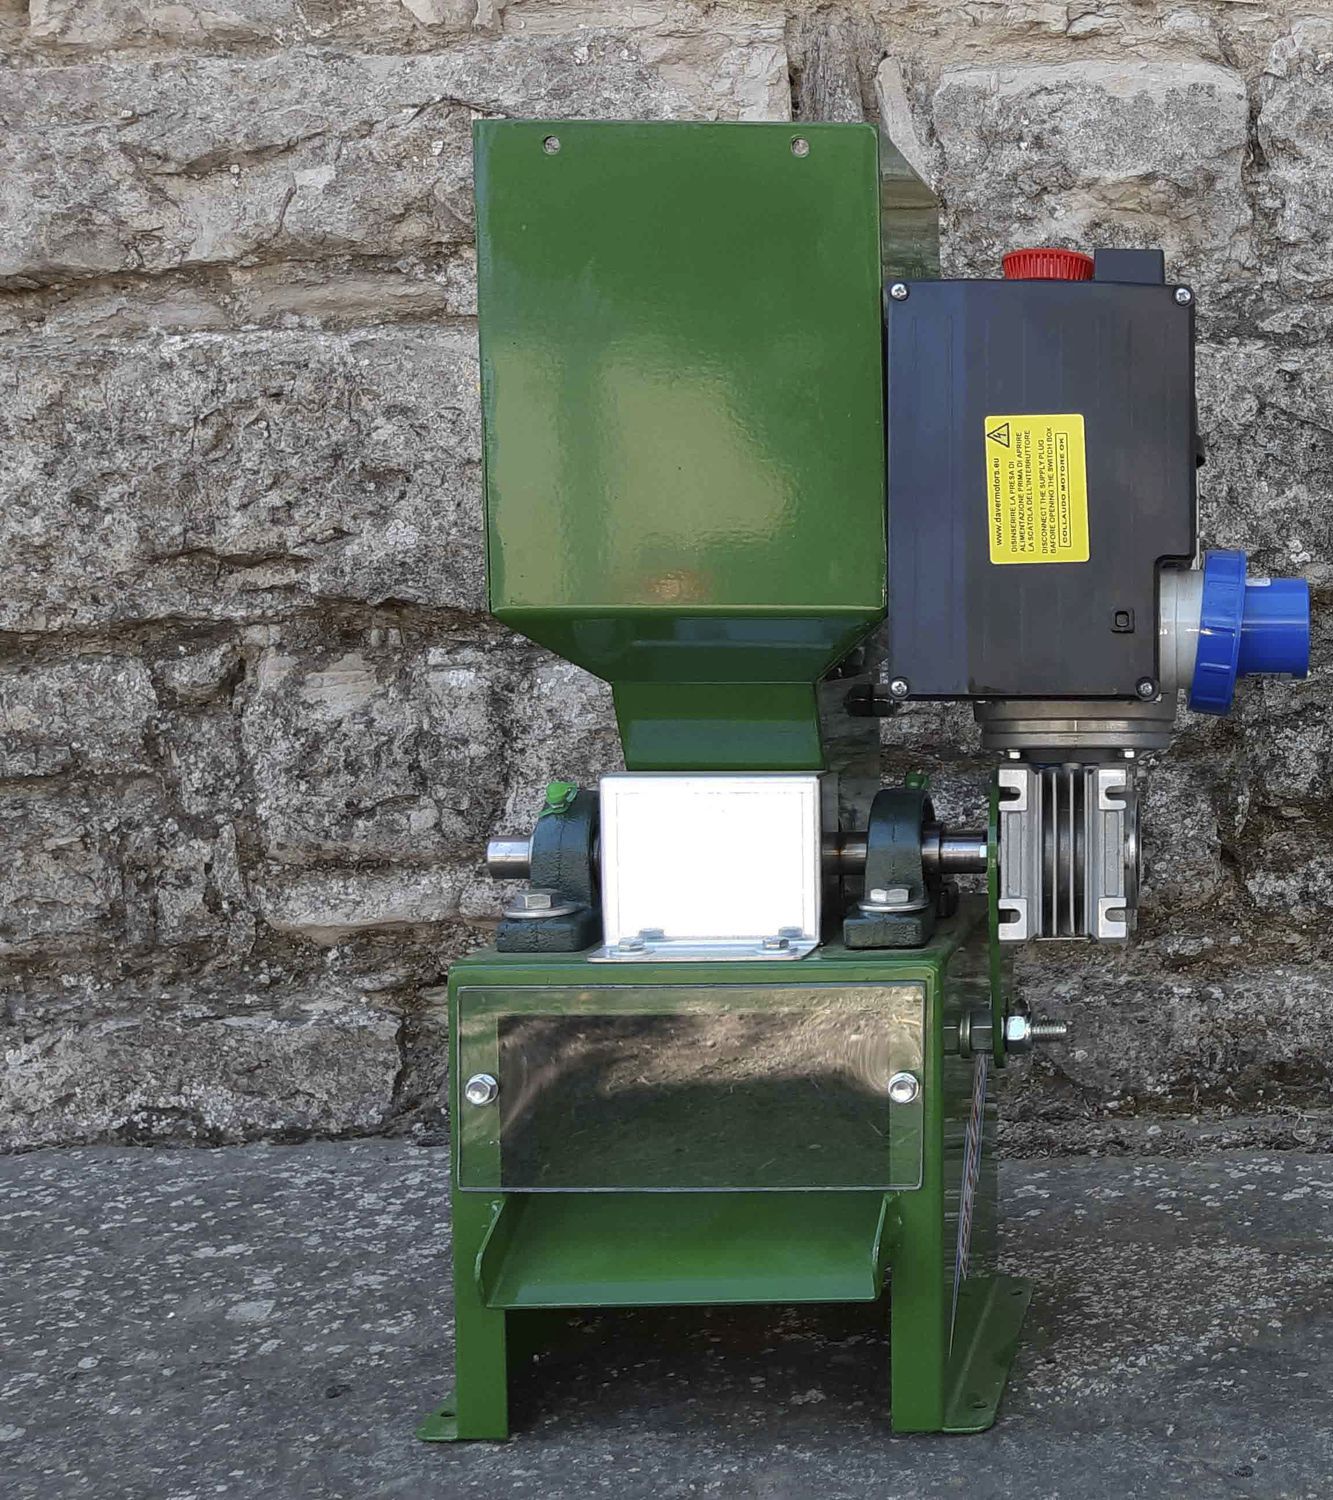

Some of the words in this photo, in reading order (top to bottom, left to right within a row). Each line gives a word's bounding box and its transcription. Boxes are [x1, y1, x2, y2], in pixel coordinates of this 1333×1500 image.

[1015, 432, 1023, 459] APRIRE
[1046, 444, 1054, 472] SWITCH
[1038, 461, 1046, 488] SUPPLY
[1047, 474, 1055, 488] THE
[993, 458, 1003, 545] www.davermotors.eu
[1048, 490, 1056, 522] OPENING
[1060, 494, 1068, 543] COLLAUDO
[1009, 507, 1018, 552] DISINSERIRE
[1018, 494, 1026, 552] ALIMENTAZIONE
[1026, 506, 1034, 540] SCATOLA
[1040, 507, 1048, 553] DISCONNECT
